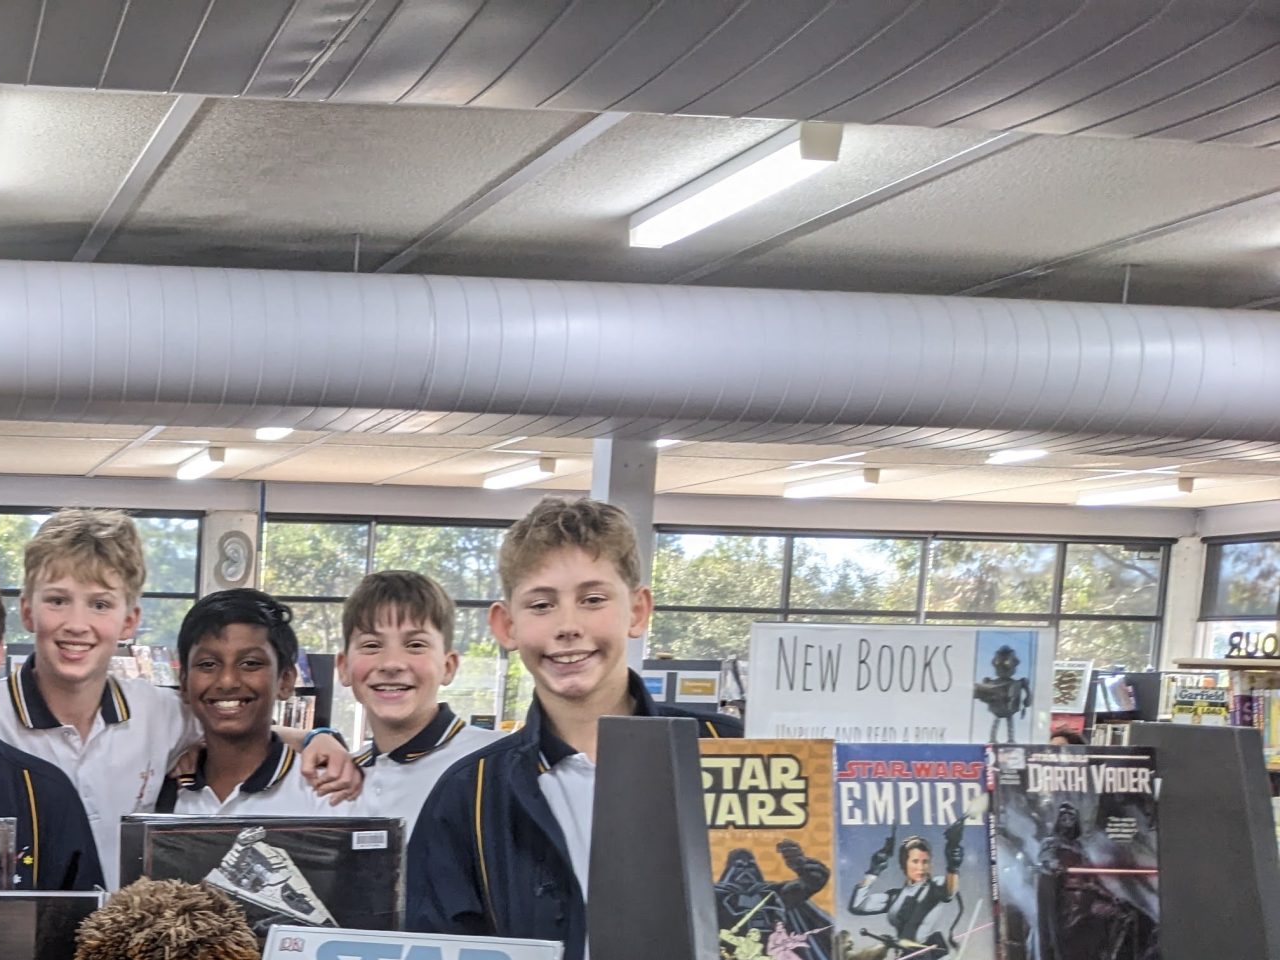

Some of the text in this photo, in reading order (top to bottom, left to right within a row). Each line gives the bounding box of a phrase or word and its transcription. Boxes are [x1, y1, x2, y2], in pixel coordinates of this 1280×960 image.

[856, 638, 953, 693] BOOKS
[1178, 689, 1226, 701] Garfield
[836, 760, 912, 779] STAR
[912, 760, 985, 780] WARS
[1026, 763, 1088, 793] DARTH
[1089, 763, 1155, 794] VADER
[704, 792, 806, 826] ARS
[838, 781, 985, 826] EMPIRE
[280, 937, 305, 951] DK
